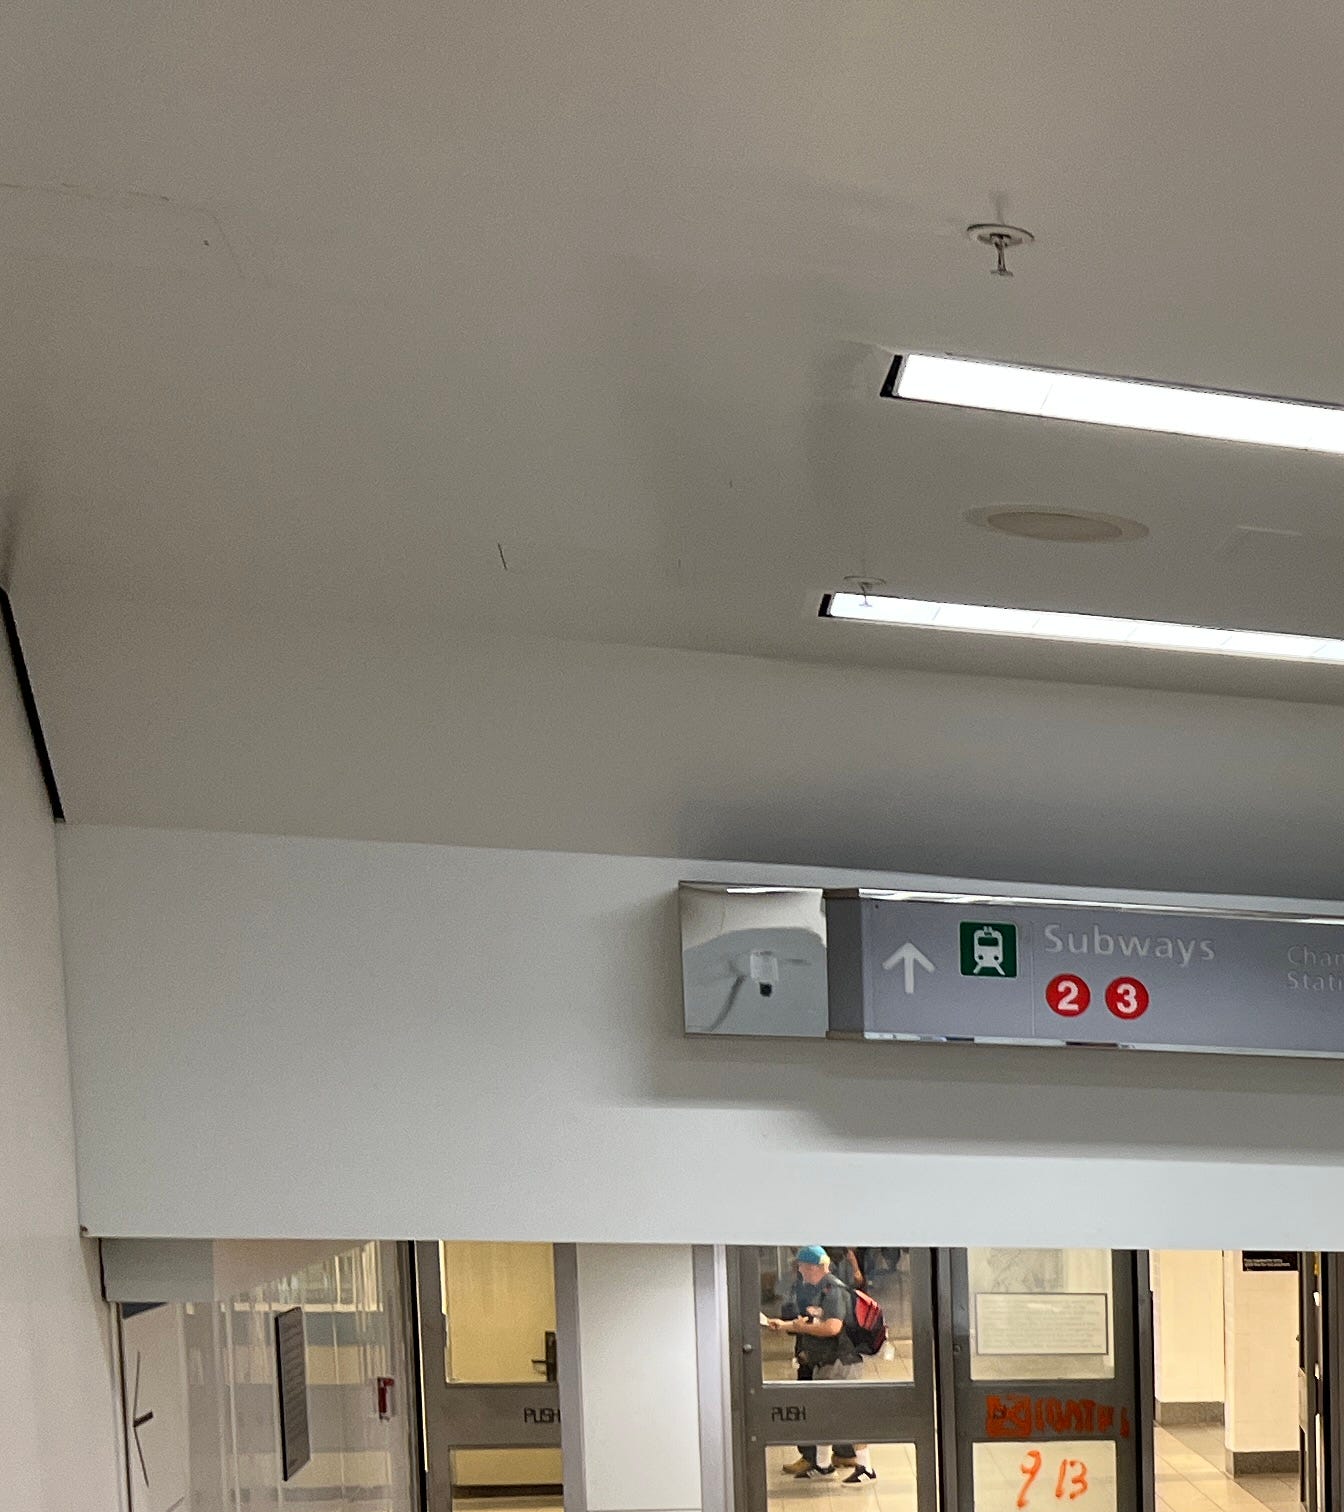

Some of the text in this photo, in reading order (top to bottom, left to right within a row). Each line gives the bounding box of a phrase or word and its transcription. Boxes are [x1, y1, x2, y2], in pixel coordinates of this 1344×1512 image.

[1044, 924, 1215, 967] Subways
[1057, 980, 1138, 1014] 2 3
[523, 1407, 561, 1423] PUSH
[771, 1406, 806, 1422] PUSH
[1016, 1450, 1089, 1510] 9 13
